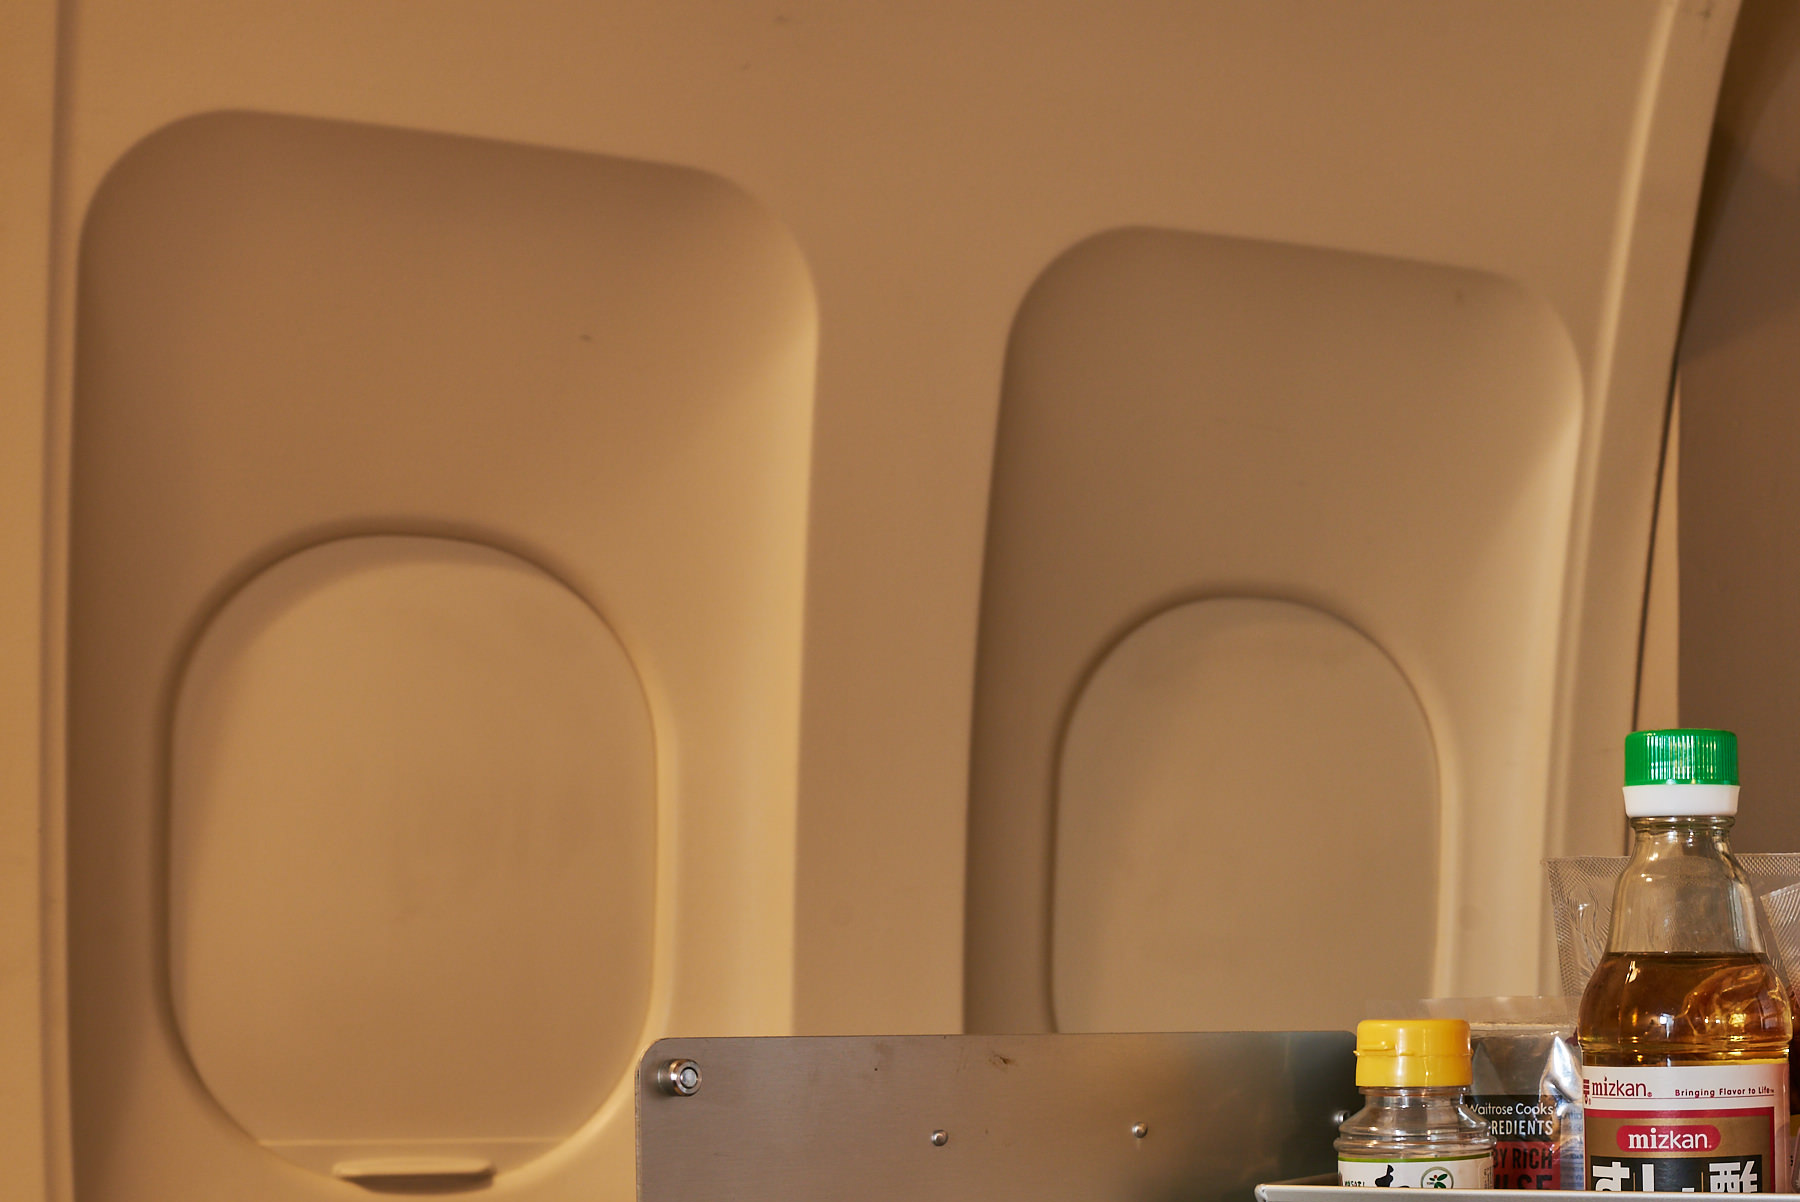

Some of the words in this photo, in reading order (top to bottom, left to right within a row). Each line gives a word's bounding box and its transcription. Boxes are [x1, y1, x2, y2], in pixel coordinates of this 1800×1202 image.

[1592, 1076, 1646, 1097] mizkan
[1675, 1089, 1715, 1098] Bringing
[1466, 1103, 1512, 1115] Waitrose
[1492, 1120, 1553, 1135] REDIENTS
[1628, 1127, 1708, 1149] mizkan
[1513, 1148, 1552, 1169] RICH
